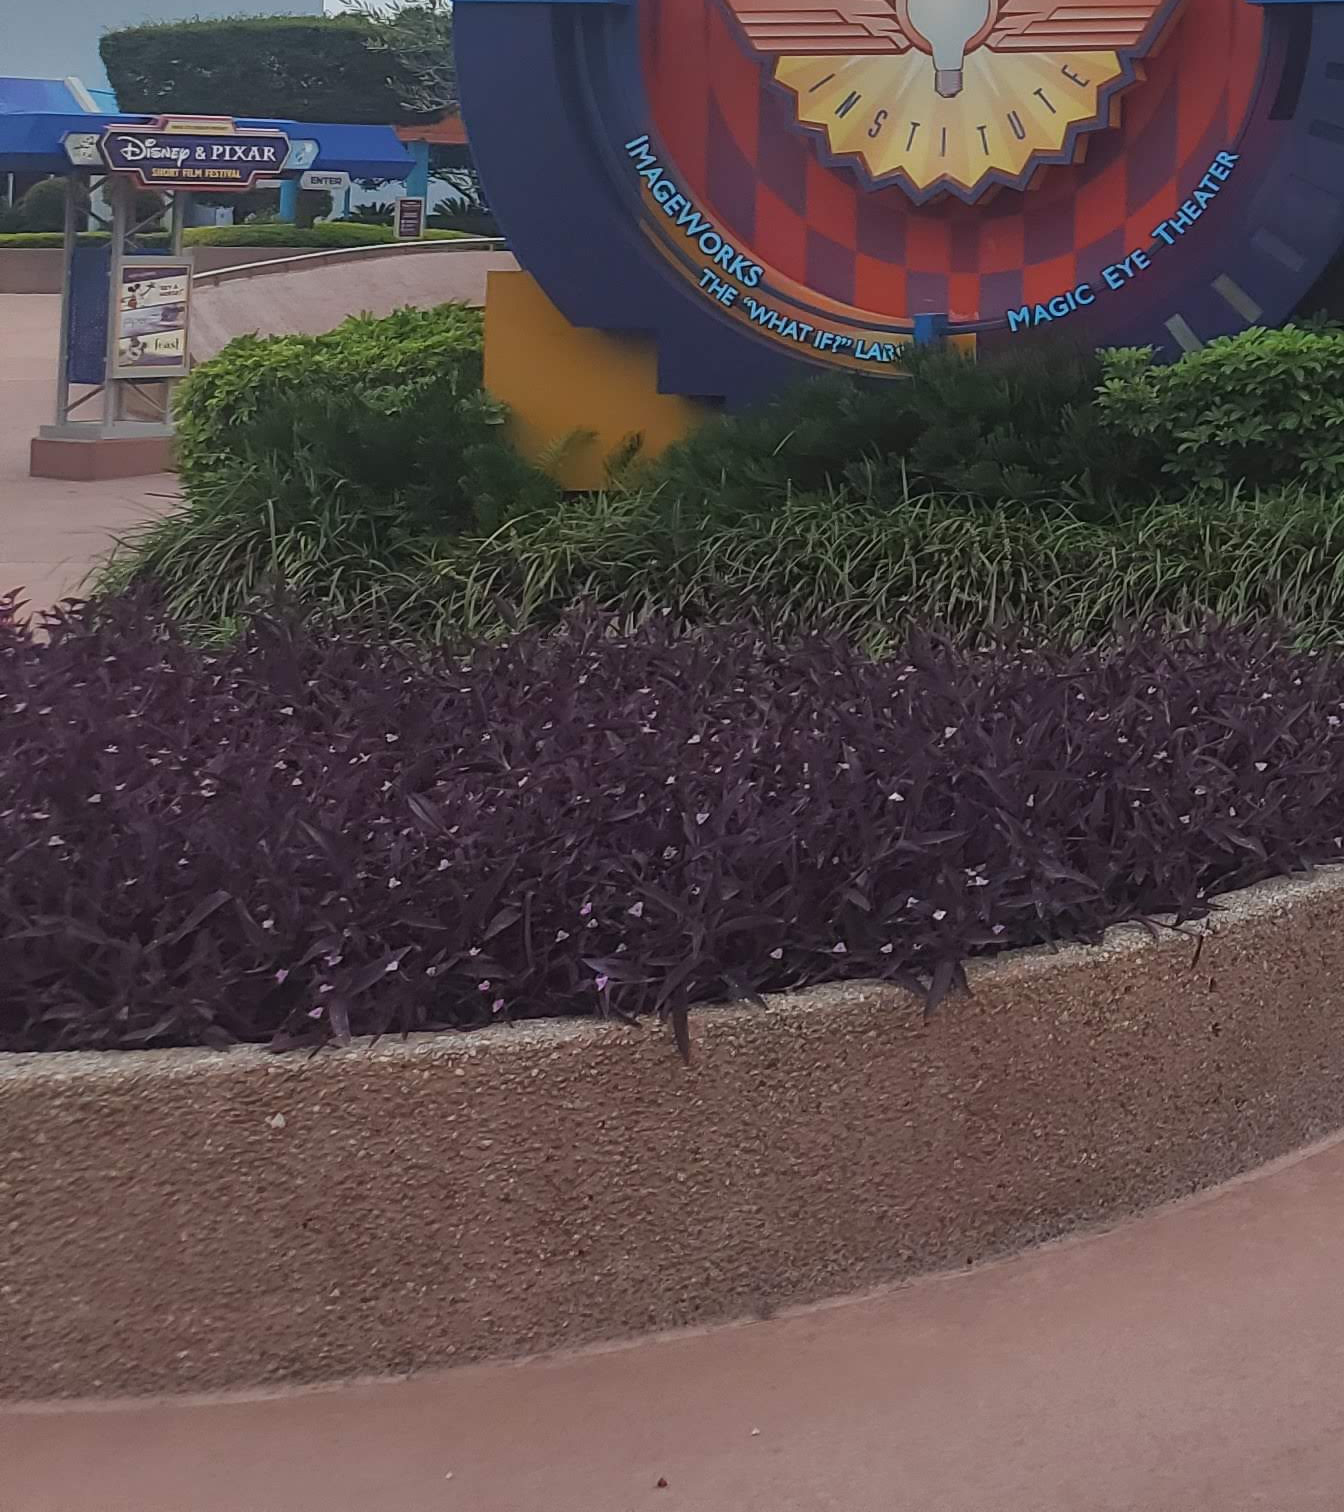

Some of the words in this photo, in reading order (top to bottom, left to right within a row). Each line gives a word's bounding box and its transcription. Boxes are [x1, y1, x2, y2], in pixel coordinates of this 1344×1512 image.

[808, 65, 1090, 157] INSTITUTE
[195, 147, 206, 161] &
[211, 145, 277, 162] PIXAR
[151, 168, 180, 178] SHORT
[182, 168, 203, 178] FILM
[204, 169, 242, 179] FESTIVAL
[310, 175, 343, 186] ENTER
[625, 135, 764, 287] IMAGEWORKS
[1006, 284, 1095, 332] MAGIC
[1101, 248, 1151, 290] EYE
[1151, 150, 1240, 246] THEATER
[699, 267, 739, 306] THE
